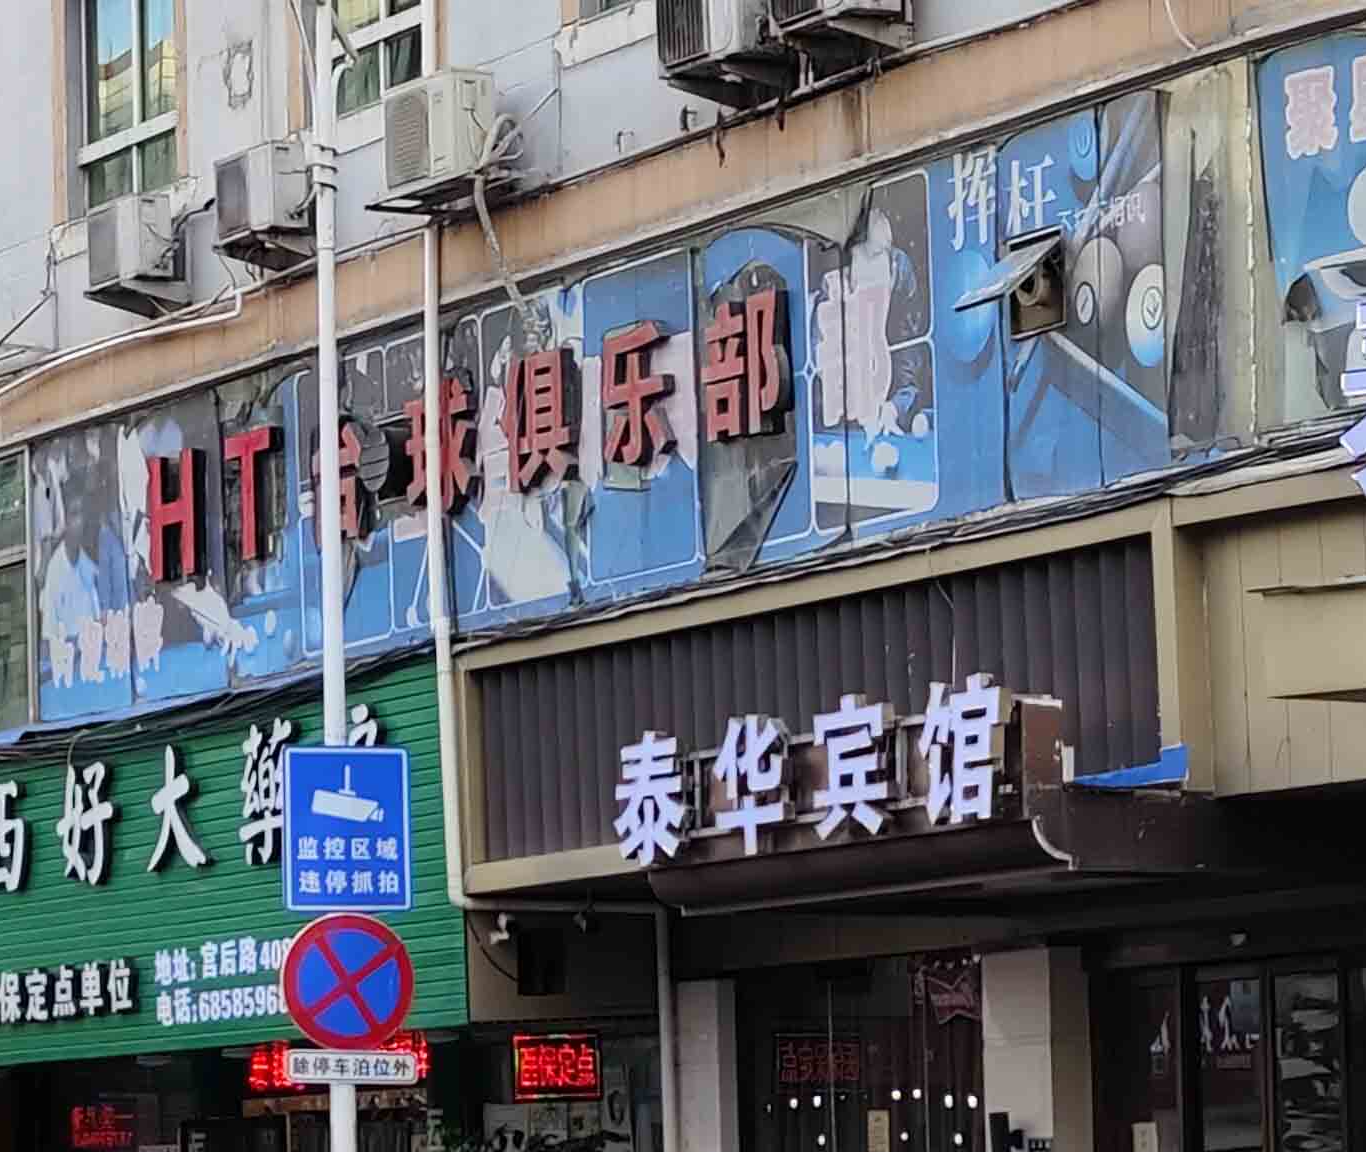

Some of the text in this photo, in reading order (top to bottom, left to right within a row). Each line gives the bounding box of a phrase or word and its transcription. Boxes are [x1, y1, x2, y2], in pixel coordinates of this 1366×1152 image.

[613, 673, 1003, 867] 泰华宾馆
[297, 836, 398, 860] 监控区域
[298, 870, 400, 894] 违停抓拍
[292, 1056, 413, 1077] 除停车泊位外
